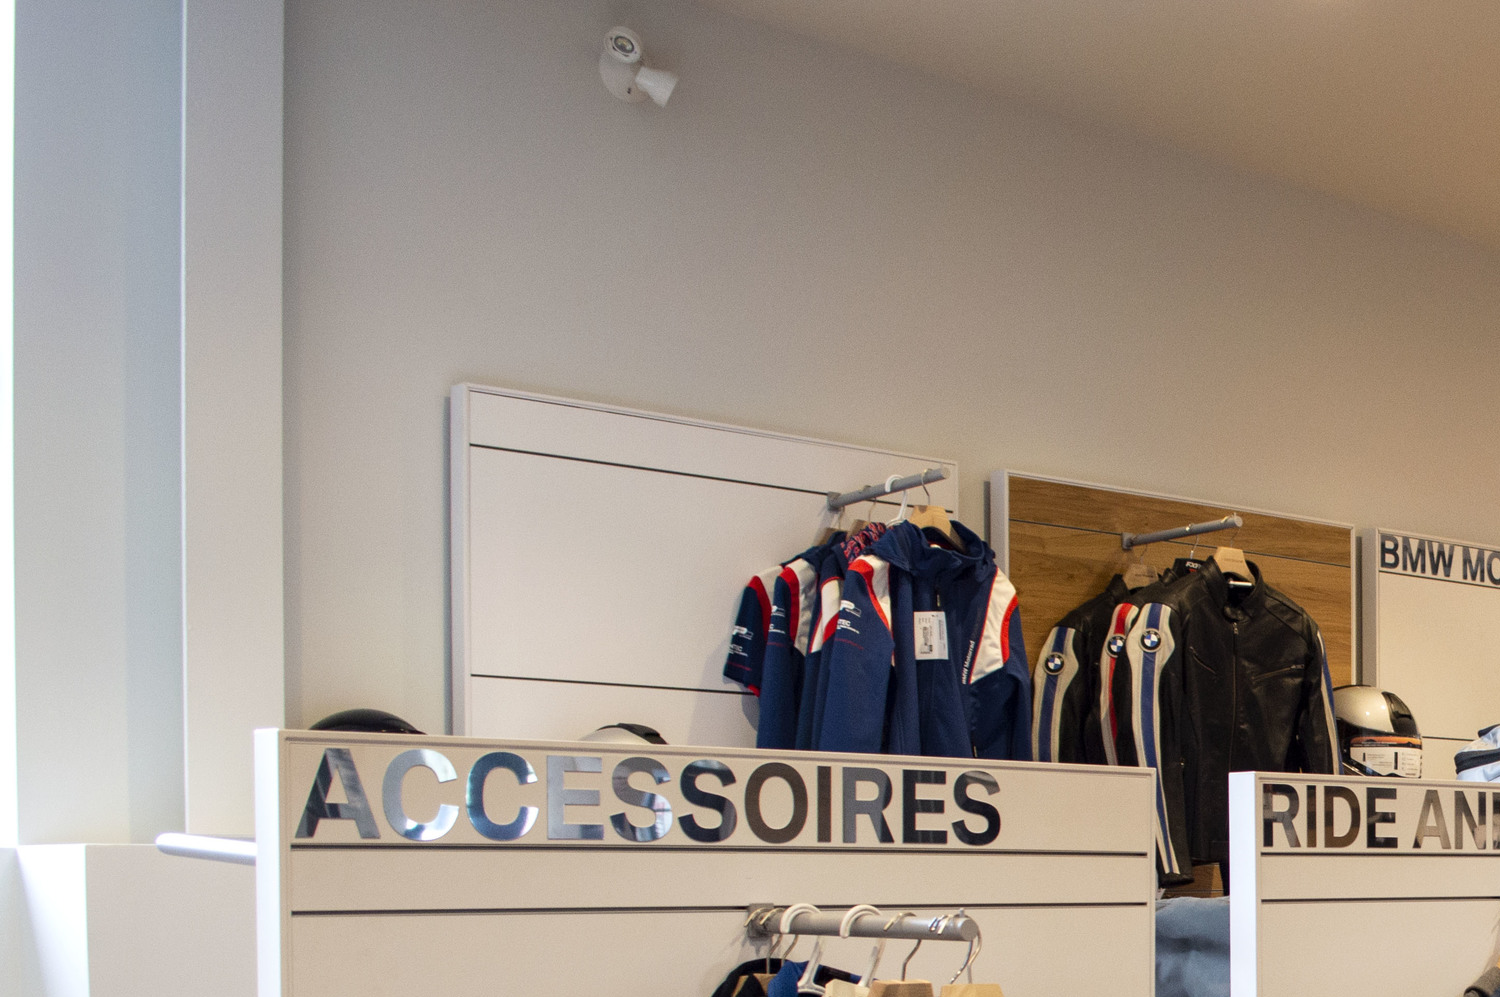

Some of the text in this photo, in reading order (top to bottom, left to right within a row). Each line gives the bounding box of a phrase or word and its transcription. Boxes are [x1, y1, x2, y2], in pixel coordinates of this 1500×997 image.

[1380, 534, 1454, 577] BMW
[294, 747, 1002, 846] ACCESSOIRES
[1262, 783, 1399, 849] RIDE
